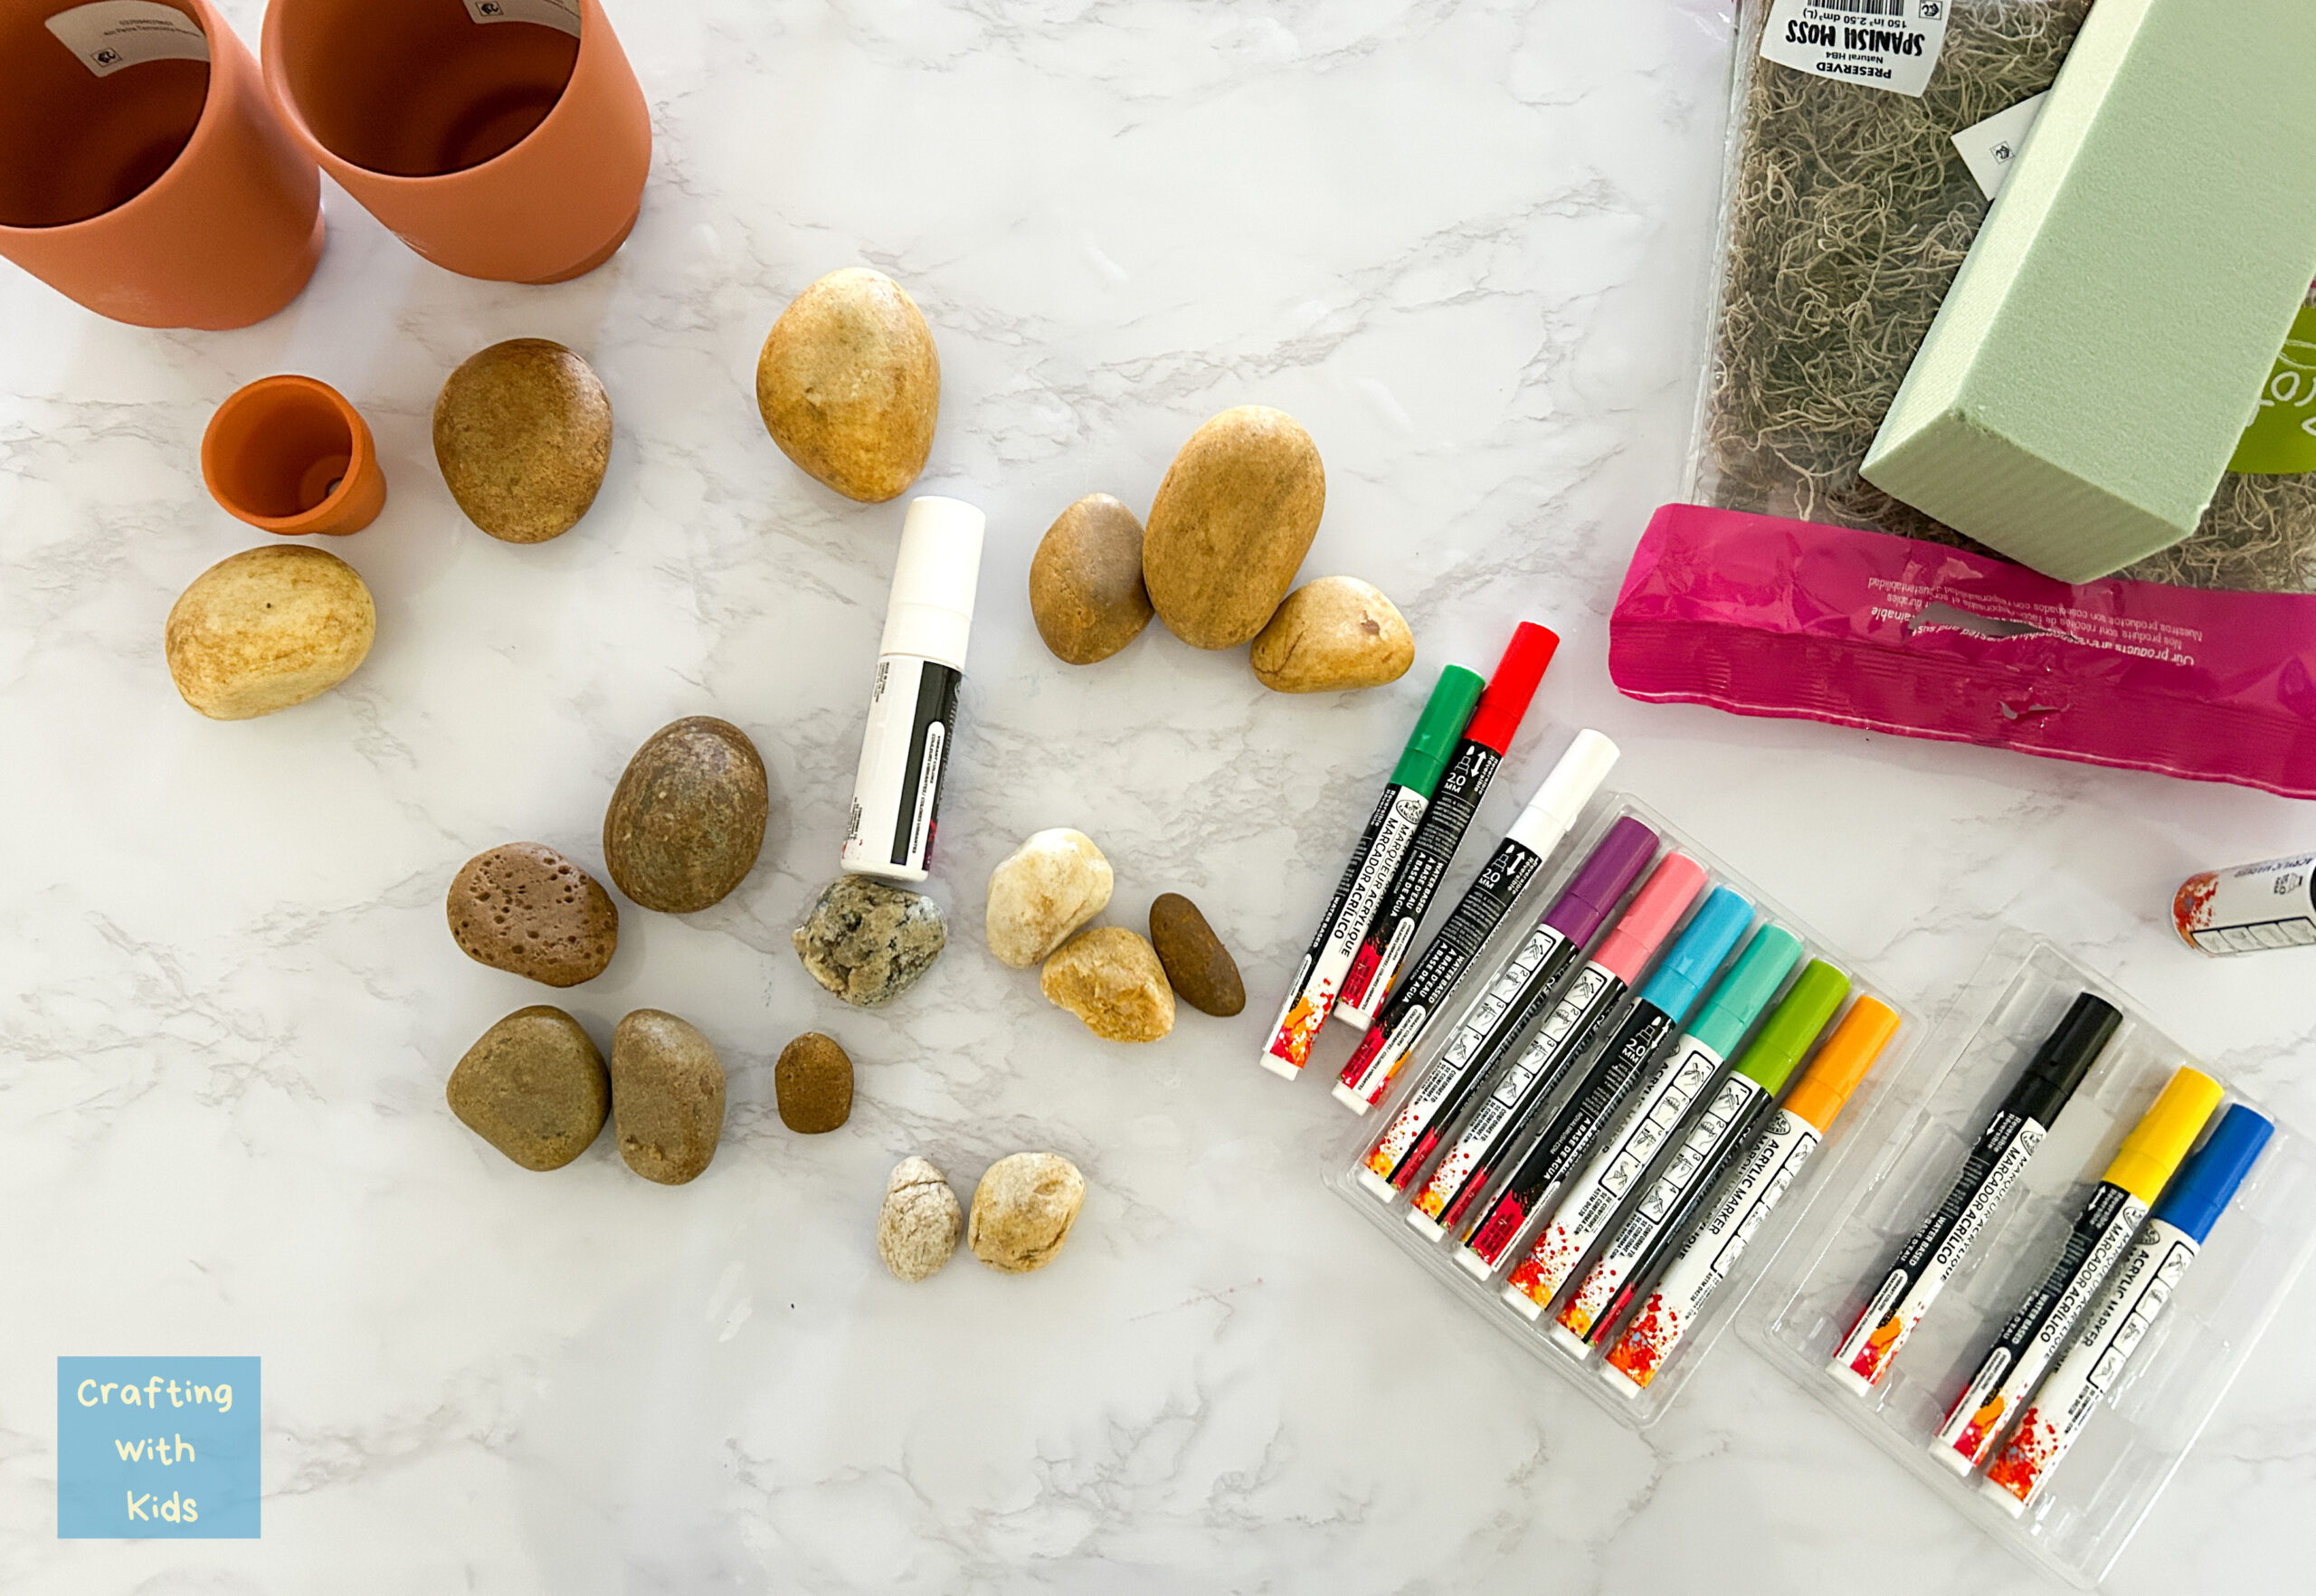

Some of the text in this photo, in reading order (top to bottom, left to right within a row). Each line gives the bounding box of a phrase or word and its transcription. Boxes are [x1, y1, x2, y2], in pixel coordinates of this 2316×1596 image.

[1802, 8, 1818, 19] (L)
[1843, 14, 1866, 24] 2.50
[1887, 19, 1906, 29] 150
[1785, 19, 1924, 57] SPANISH MOSS
[1815, 61, 1892, 78] PRESERVED
[1825, 52, 1883, 63] Natural HB4
[1886, 594, 1922, 609] durables
[1443, 781, 1461, 794] MM
[1373, 789, 1396, 827] Reversible
[1359, 817, 1399, 883] MARCADOR
[1371, 823, 1410, 889] MARQUEUR
[1389, 851, 1426, 917] A BASE DE AGUA
[1417, 863, 1431, 885] BASE
[1477, 876, 1494, 890] MM
[1506, 856, 1534, 891] Réversible
[1405, 884, 1421, 908] D'EAU
[1414, 860, 1444, 913] WATER BASED
[1311, 895, 1341, 948] WATER BASED
[1333, 882, 1369, 941] ACRÍLICO
[1339, 888, 1379, 957] ACRYLIQUE
[1424, 948, 1443, 970] BASE
[1433, 955, 1450, 975] BASE
[1417, 970, 1428, 981] DE
[1427, 955, 1464, 1003] WATER BASED
[1519, 969, 1528, 977] 2
[1401, 981, 1419, 1003] AGUA
[1418, 974, 1438, 998] D'EAU
[1495, 1001, 1504, 1009] 3
[1570, 1007, 1579, 1015] 2
[1472, 1032, 1481, 1040] 4
[1546, 1040, 1555, 1048] 3
[1624, 1037, 1647, 1057] 2.0
[1619, 1046, 1640, 1063] MM
[1435, 1069, 1456, 1096] CONFORMS
[1443, 1066, 1450, 1074] SE
[1523, 1071, 1532, 1079] 4
[1475, 1104, 1501, 1137] SE CONFORME
[1484, 1107, 1506, 1135] CONFORMS
[1549, 1111, 1583, 1154] ROYALBRUSH.COM
[1583, 1116, 1591, 1125] A
[1715, 1120, 1724, 1128] 2
[1568, 1124, 1587, 1145] BASE
[1991, 1116, 2021, 1154] Reversible
[1560, 1145, 1571, 1157] DE
[1691, 1153, 1701, 1161] 3
[1741, 1138, 1780, 1188] ACRYLIC
[1542, 1155, 1562, 1180] AGUA
[1971, 1146, 2020, 1211] MARCADOR
[1587, 1186, 1601, 1202] ASTM
[1598, 1192, 1607, 1200] SE
[1668, 1185, 1677, 1193] 4
[1981, 1155, 2027, 1219] MARQUEUR
[1580, 1198, 1601, 1224] CONFORMA
[1585, 1203, 1606, 1229] CONFORME
[1633, 1215, 1642, 1224] SE
[1707, 1186, 1746, 1235] MARKER
[2094, 1191, 2123, 1230] Reversible
[1615, 1222, 1637, 1249] CONFORMA
[1619, 1219, 1647, 1253] SE CONFORME
[1631, 1223, 1653, 1249] CONFORMS
[1907, 1214, 1946, 1266] WATER BASED
[1935, 1208, 1979, 1266] ACRÍLICO
[1939, 1218, 1985, 1283] ACRYLIQUE
[2074, 1222, 2123, 1288] MARCADOR
[1700, 1271, 1713, 1286] ASTM
[2112, 1249, 2150, 1299] ACRYLIC
[2010, 1292, 2048, 1344] WATER BASED
[2038, 1286, 2083, 1344] ACRÍLICO
[2082, 1298, 2118, 1347] MARKER
[2042, 1295, 2088, 1361] ACRYLIQUE
